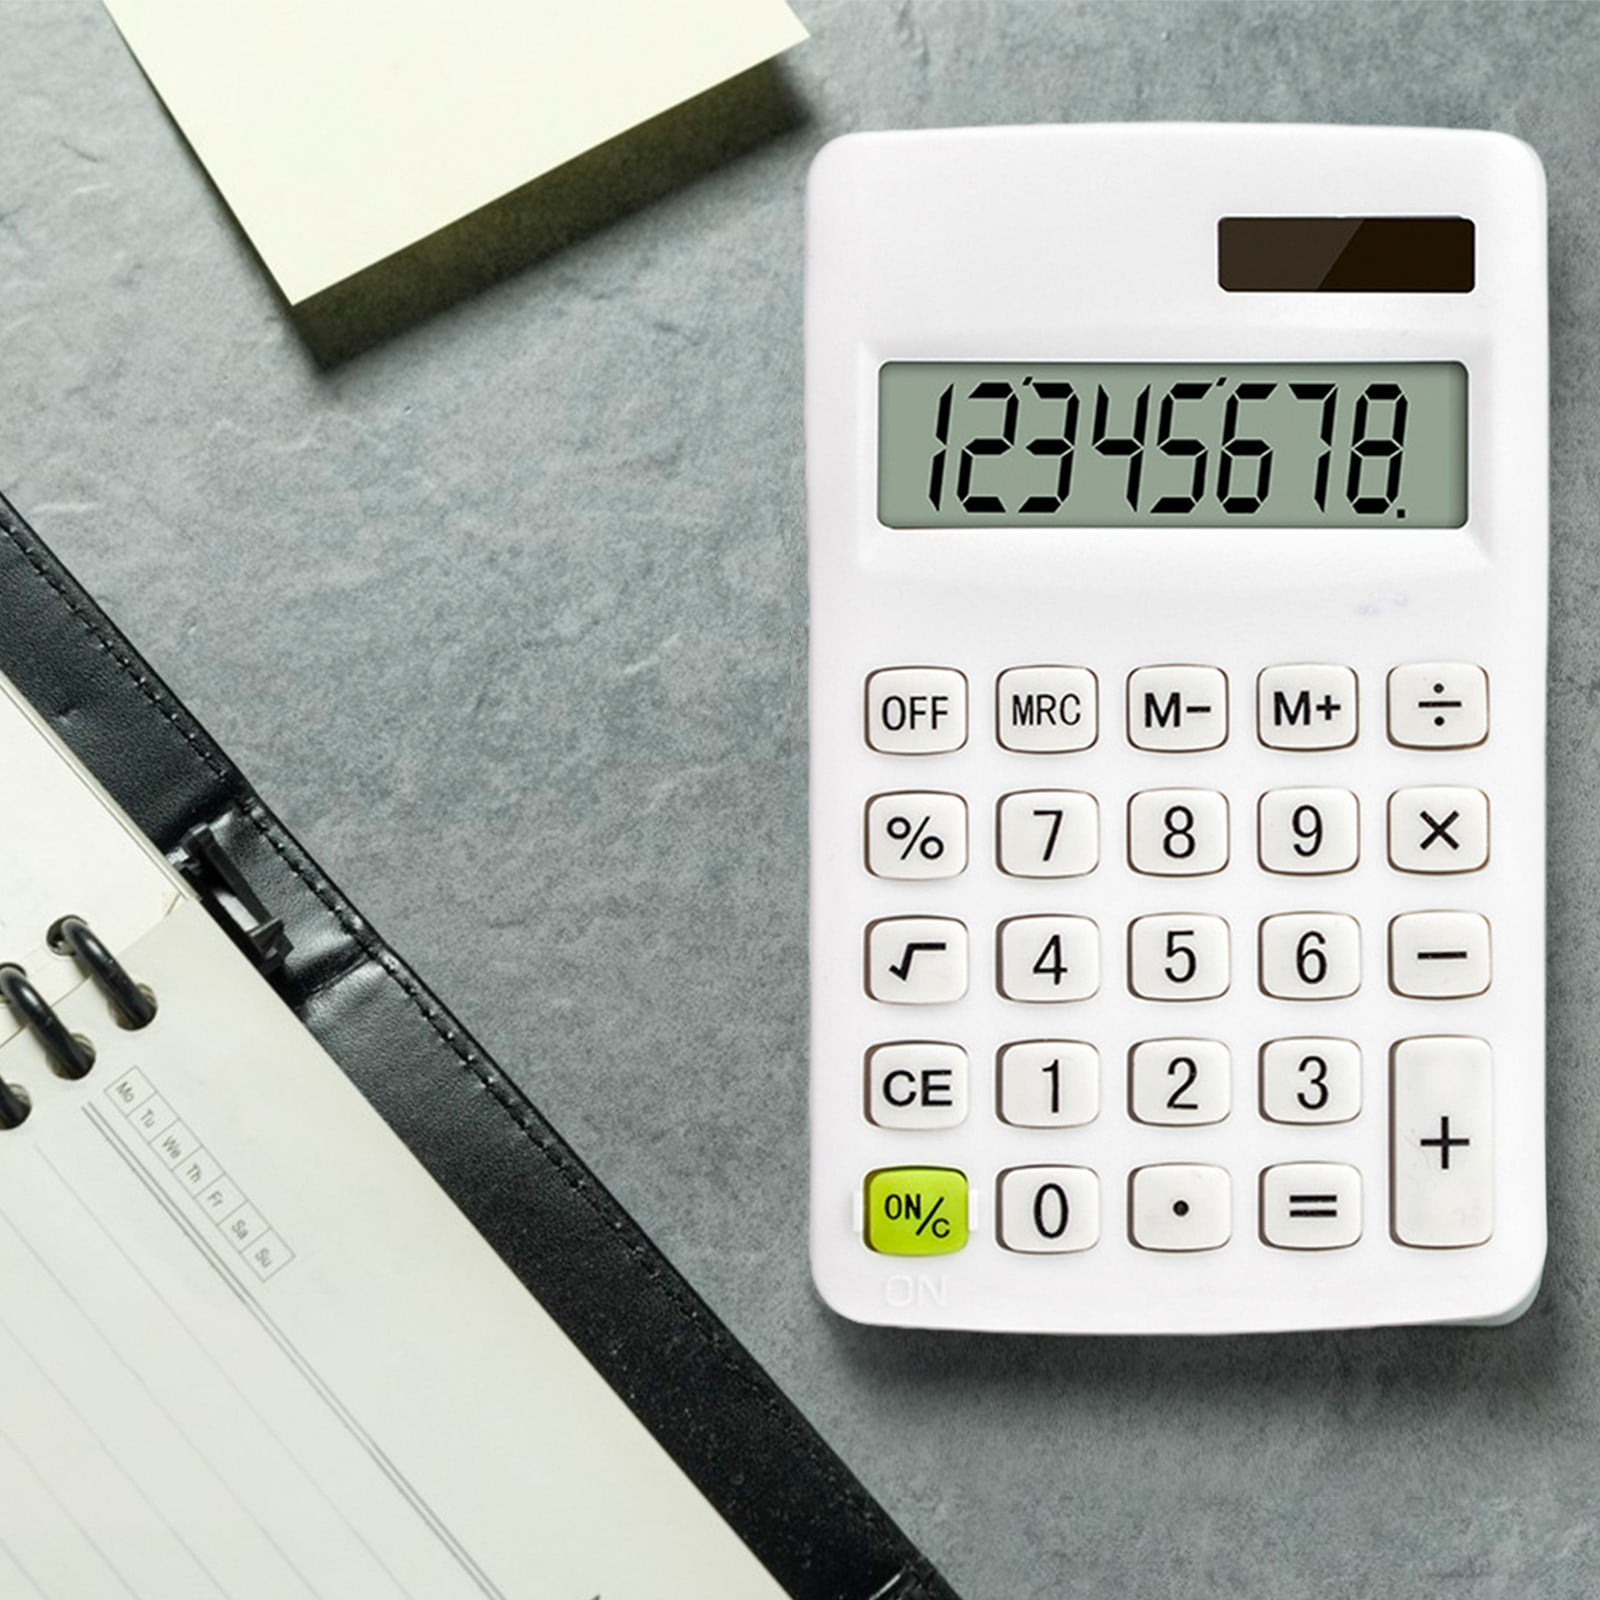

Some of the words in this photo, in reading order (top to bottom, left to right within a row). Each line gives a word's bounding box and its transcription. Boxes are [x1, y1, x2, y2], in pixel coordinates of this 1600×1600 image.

[881, 695, 949, 731] OFF
[1012, 693, 1081, 726] MRC
[1273, 690, 1341, 727] M+
[886, 815, 945, 861] %
[1033, 809, 1063, 862] 7
[1163, 805, 1196, 859] 8
[1292, 804, 1323, 858] 9
[1032, 934, 1068, 986] 4
[1164, 930, 1197, 984] 5
[1296, 930, 1327, 985] 6
[882, 1069, 953, 1108] CE
[1042, 1059, 1060, 1114] 1
[1166, 1056, 1199, 1110] 2
[1297, 1055, 1329, 1111] 3
[116, 1081, 135, 1103] Mo
[140, 1108, 155, 1129] Tu
[163, 1135, 181, 1159] We
[186, 1163, 202, 1184] Th
[207, 1190, 223, 1207] Fr
[231, 1219, 249, 1240] Sa
[255, 1247, 272, 1269] Su
[1033, 1182, 1069, 1239] 0
